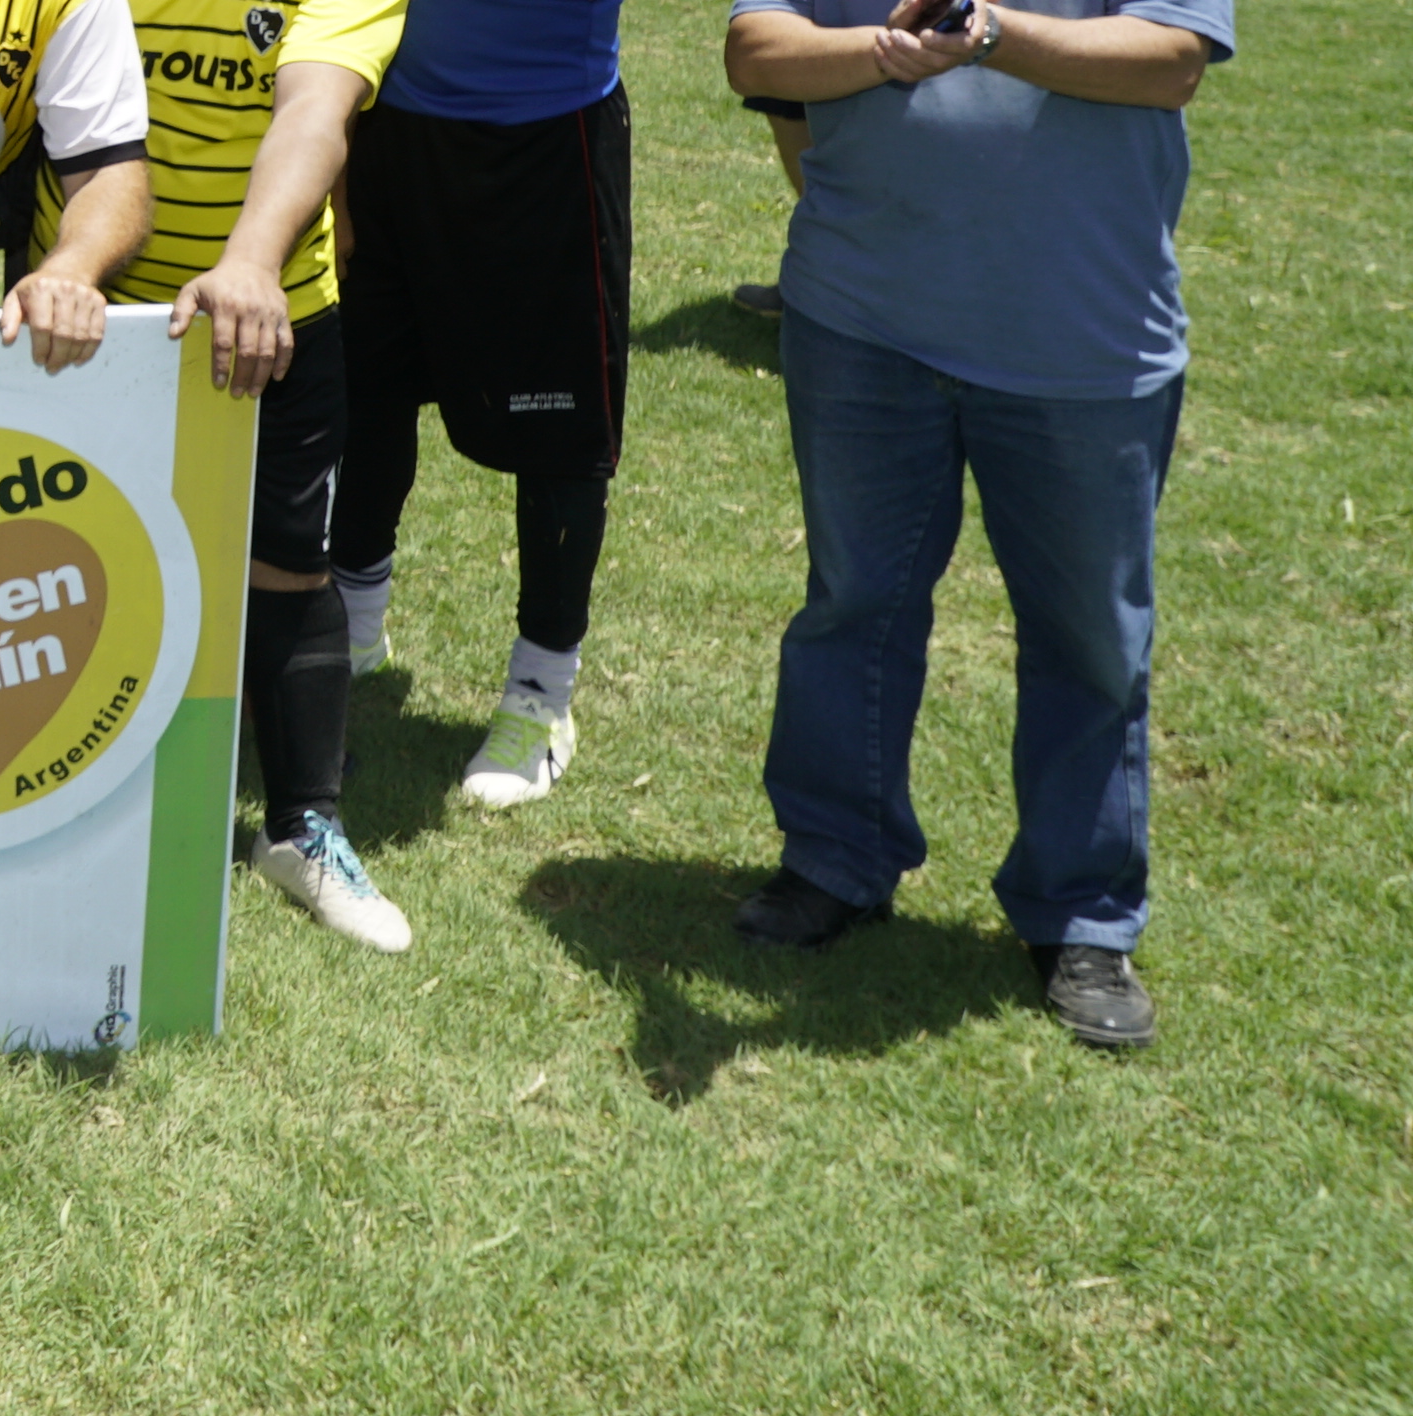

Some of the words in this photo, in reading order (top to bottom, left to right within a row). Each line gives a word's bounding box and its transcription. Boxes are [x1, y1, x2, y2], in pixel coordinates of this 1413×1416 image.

[250, 10, 275, 44] DFC
[142, 50, 254, 91] TOURS
[13, 672, 140, 798] Argentina
